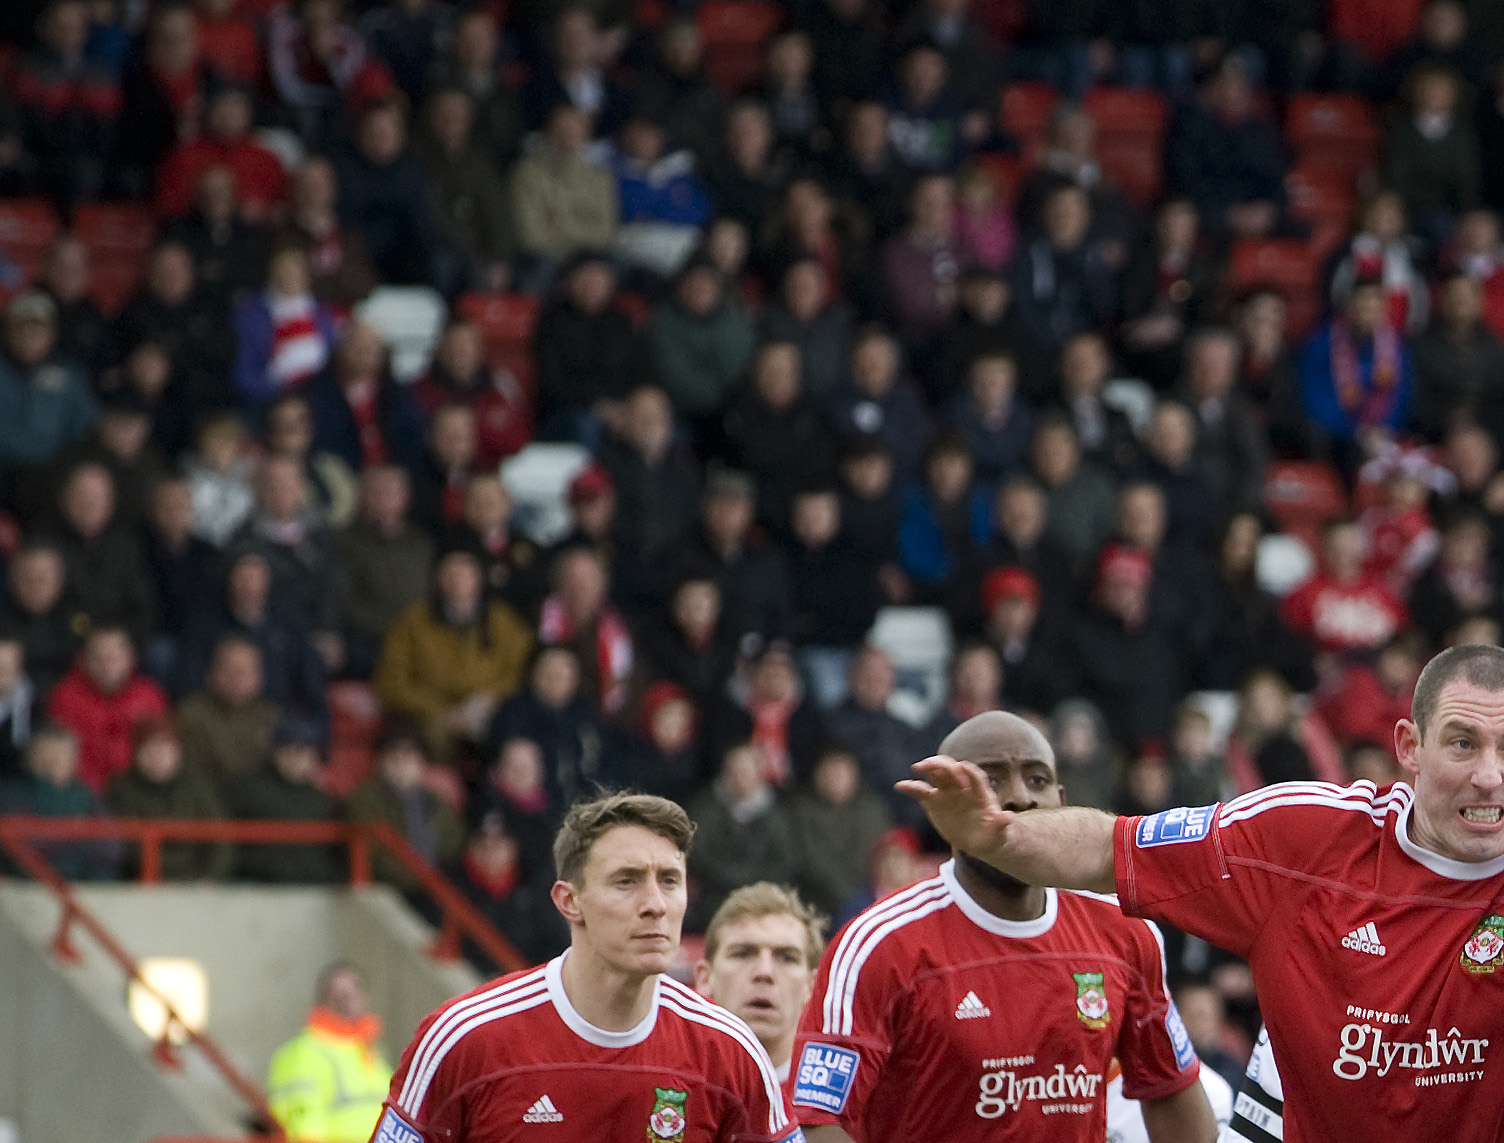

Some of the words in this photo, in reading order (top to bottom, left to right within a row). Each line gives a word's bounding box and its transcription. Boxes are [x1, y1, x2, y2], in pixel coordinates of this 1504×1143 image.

[1341, 936, 1387, 957] adidas
[803, 1048, 853, 1074] BLUE
[799, 1065, 829, 1087] SQ
[1415, 1070, 1485, 1088] UNIVERSITY
